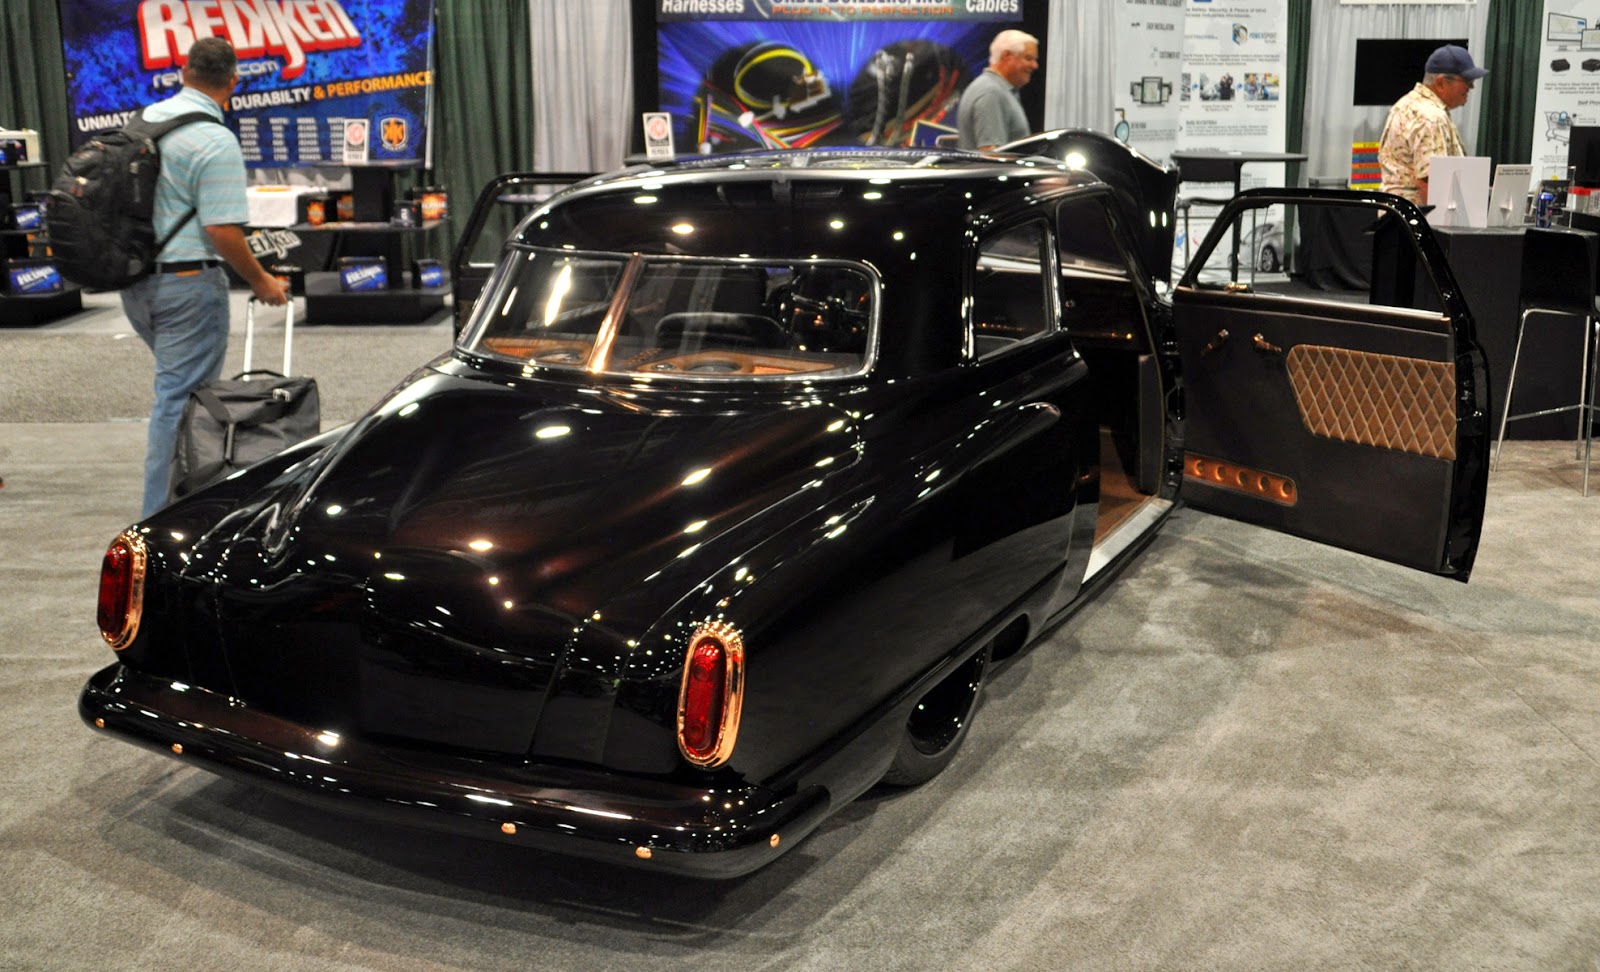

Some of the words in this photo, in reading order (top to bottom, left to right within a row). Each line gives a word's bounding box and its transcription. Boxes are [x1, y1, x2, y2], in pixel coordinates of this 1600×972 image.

[661, 0, 745, 13] Harnesses
[772, 6, 813, 15] PLUG
[818, 6, 831, 15] IN
[838, 6, 856, 15] TO
[861, 6, 953, 15] PERFECTION
[965, 0, 1019, 13] Cables
[231, 87, 312, 111] DURABILTY
[313, 88, 326, 99] &
[327, 71, 432, 97] PERFORMANCE
